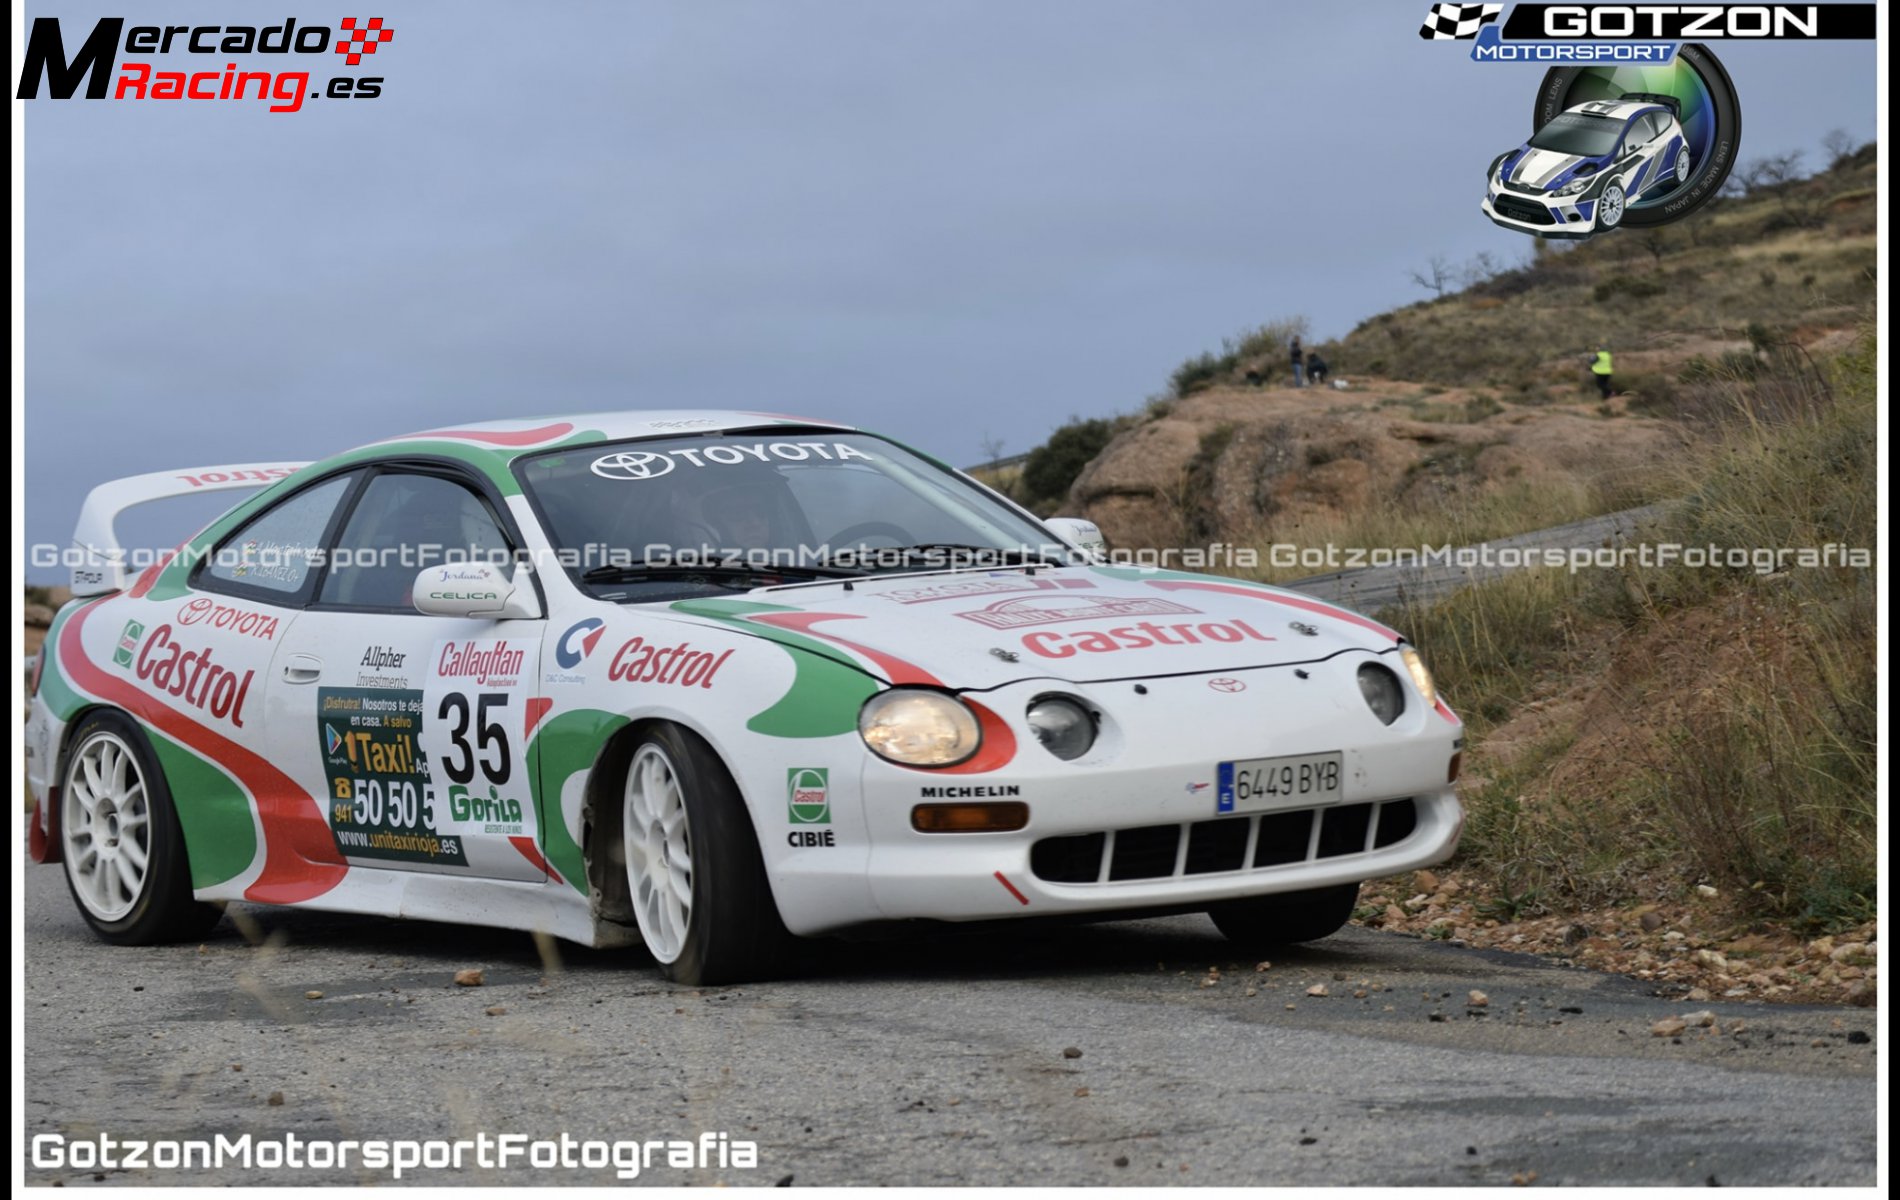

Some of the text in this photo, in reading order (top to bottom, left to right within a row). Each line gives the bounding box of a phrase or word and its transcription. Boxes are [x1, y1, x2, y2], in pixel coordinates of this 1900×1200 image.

[669, 443, 873, 467] TOYOTA
[430, 592, 497, 600] CELICA
[206, 605, 279, 640] TOYOTA
[1021, 619, 1277, 659] Castrol
[360, 646, 407, 671] Allpher
[608, 636, 736, 690] Castrol
[136, 624, 255, 729] Castrol
[356, 671, 408, 689] Investments
[362, 698, 397, 711] Nosotros
[399, 700, 406, 711] te
[351, 716, 412, 728] en casa. A salvo
[438, 692, 511, 785] 35
[921, 784, 1021, 798] MICHELIN
[1237, 766, 1294, 800] 6449
[1299, 761, 1340, 794] BYB
[335, 803, 353, 823] 941
[354, 779, 383, 826] 50
[388, 781, 417, 828] 50
[337, 830, 459, 858] www.unitaxirioja.es
[787, 829, 835, 848] CIBIÉ
